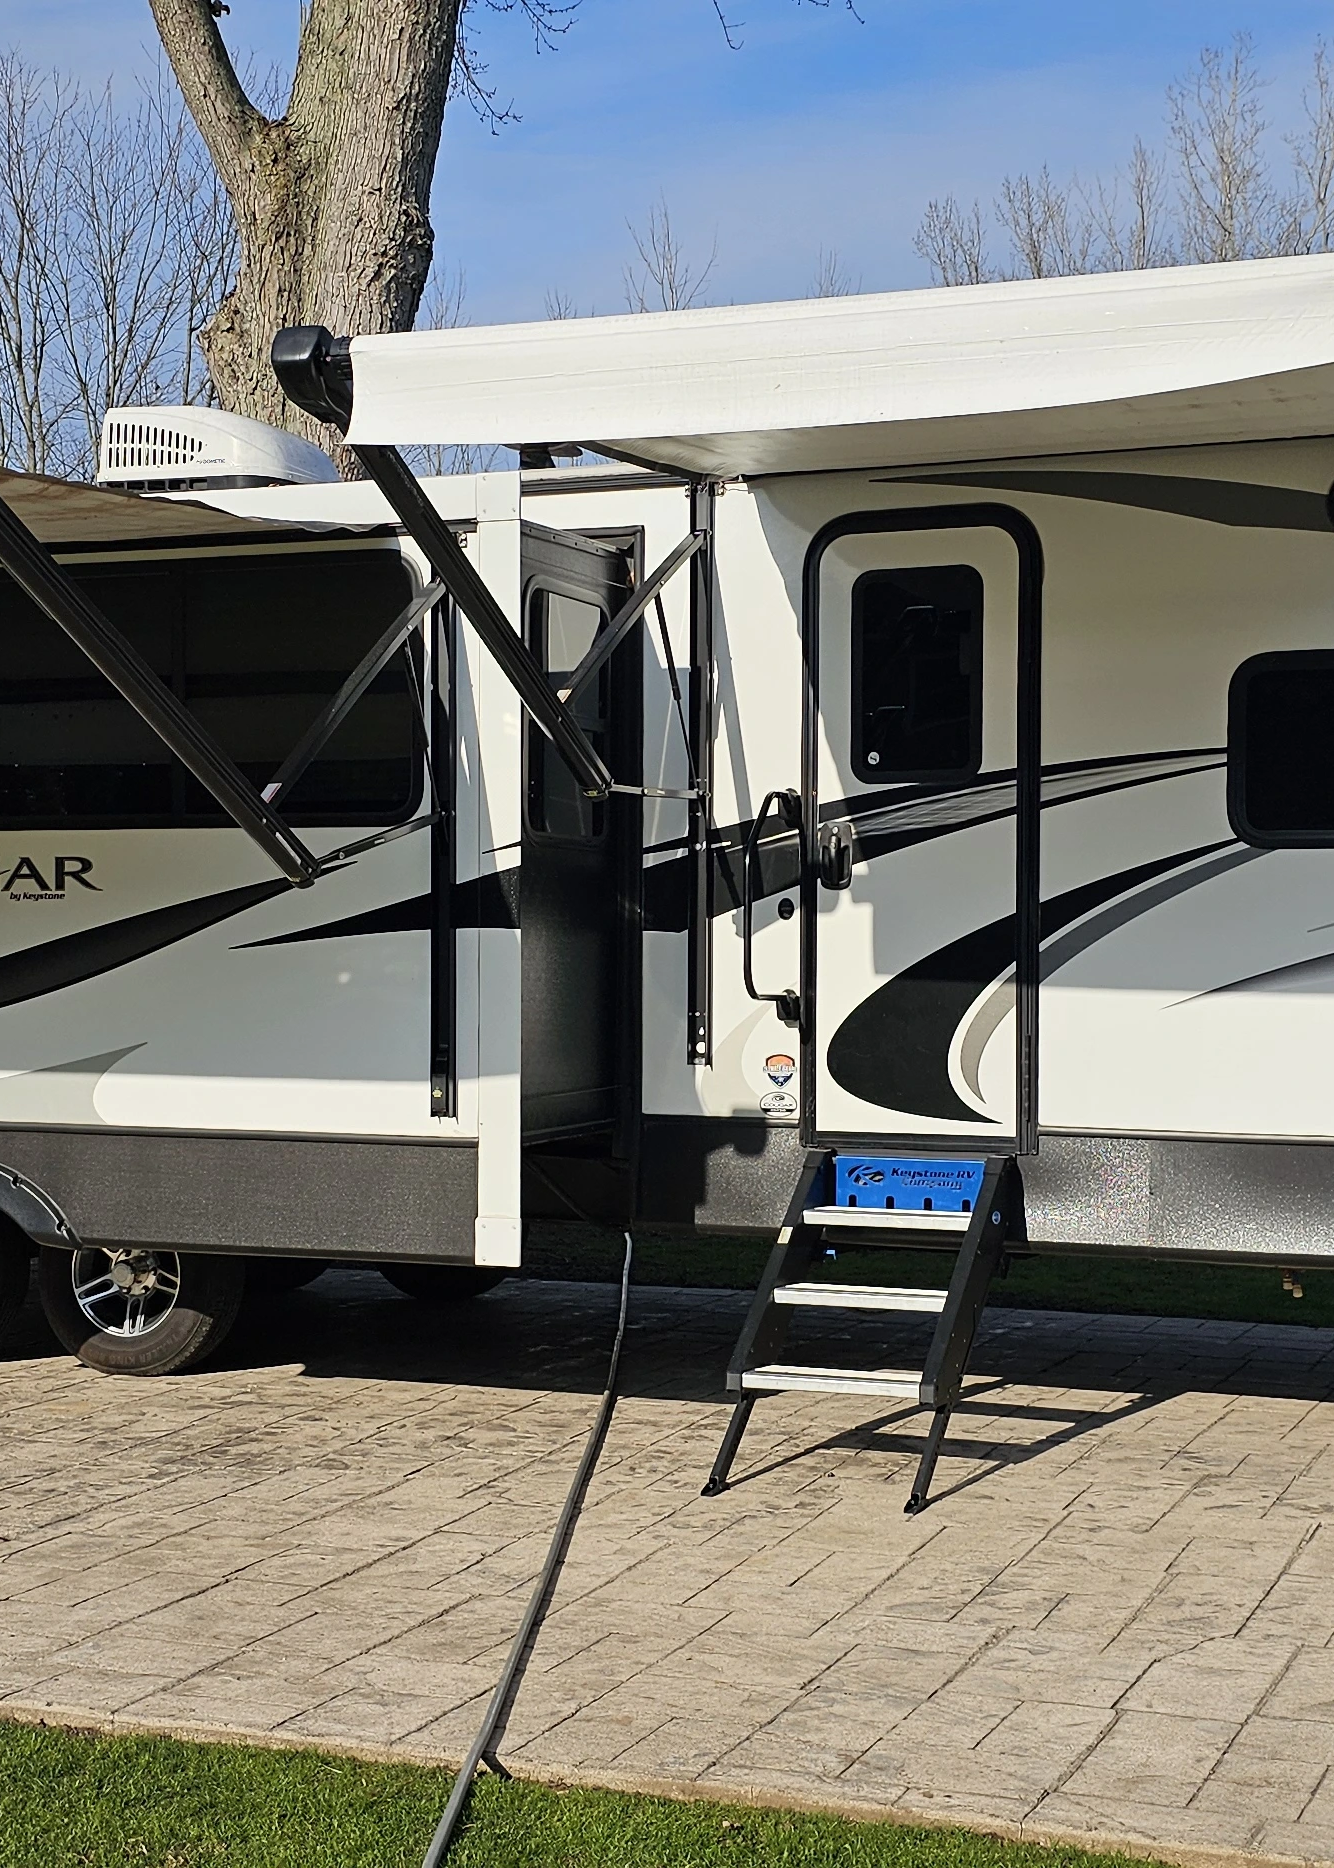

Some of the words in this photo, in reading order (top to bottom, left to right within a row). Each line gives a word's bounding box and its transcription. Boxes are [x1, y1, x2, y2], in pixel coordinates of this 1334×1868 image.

[9, 891, 21, 902] by
[23, 891, 66, 902] Keystone
[890, 1167, 955, 1180] Keystone
[956, 1170, 976, 1179] RV
